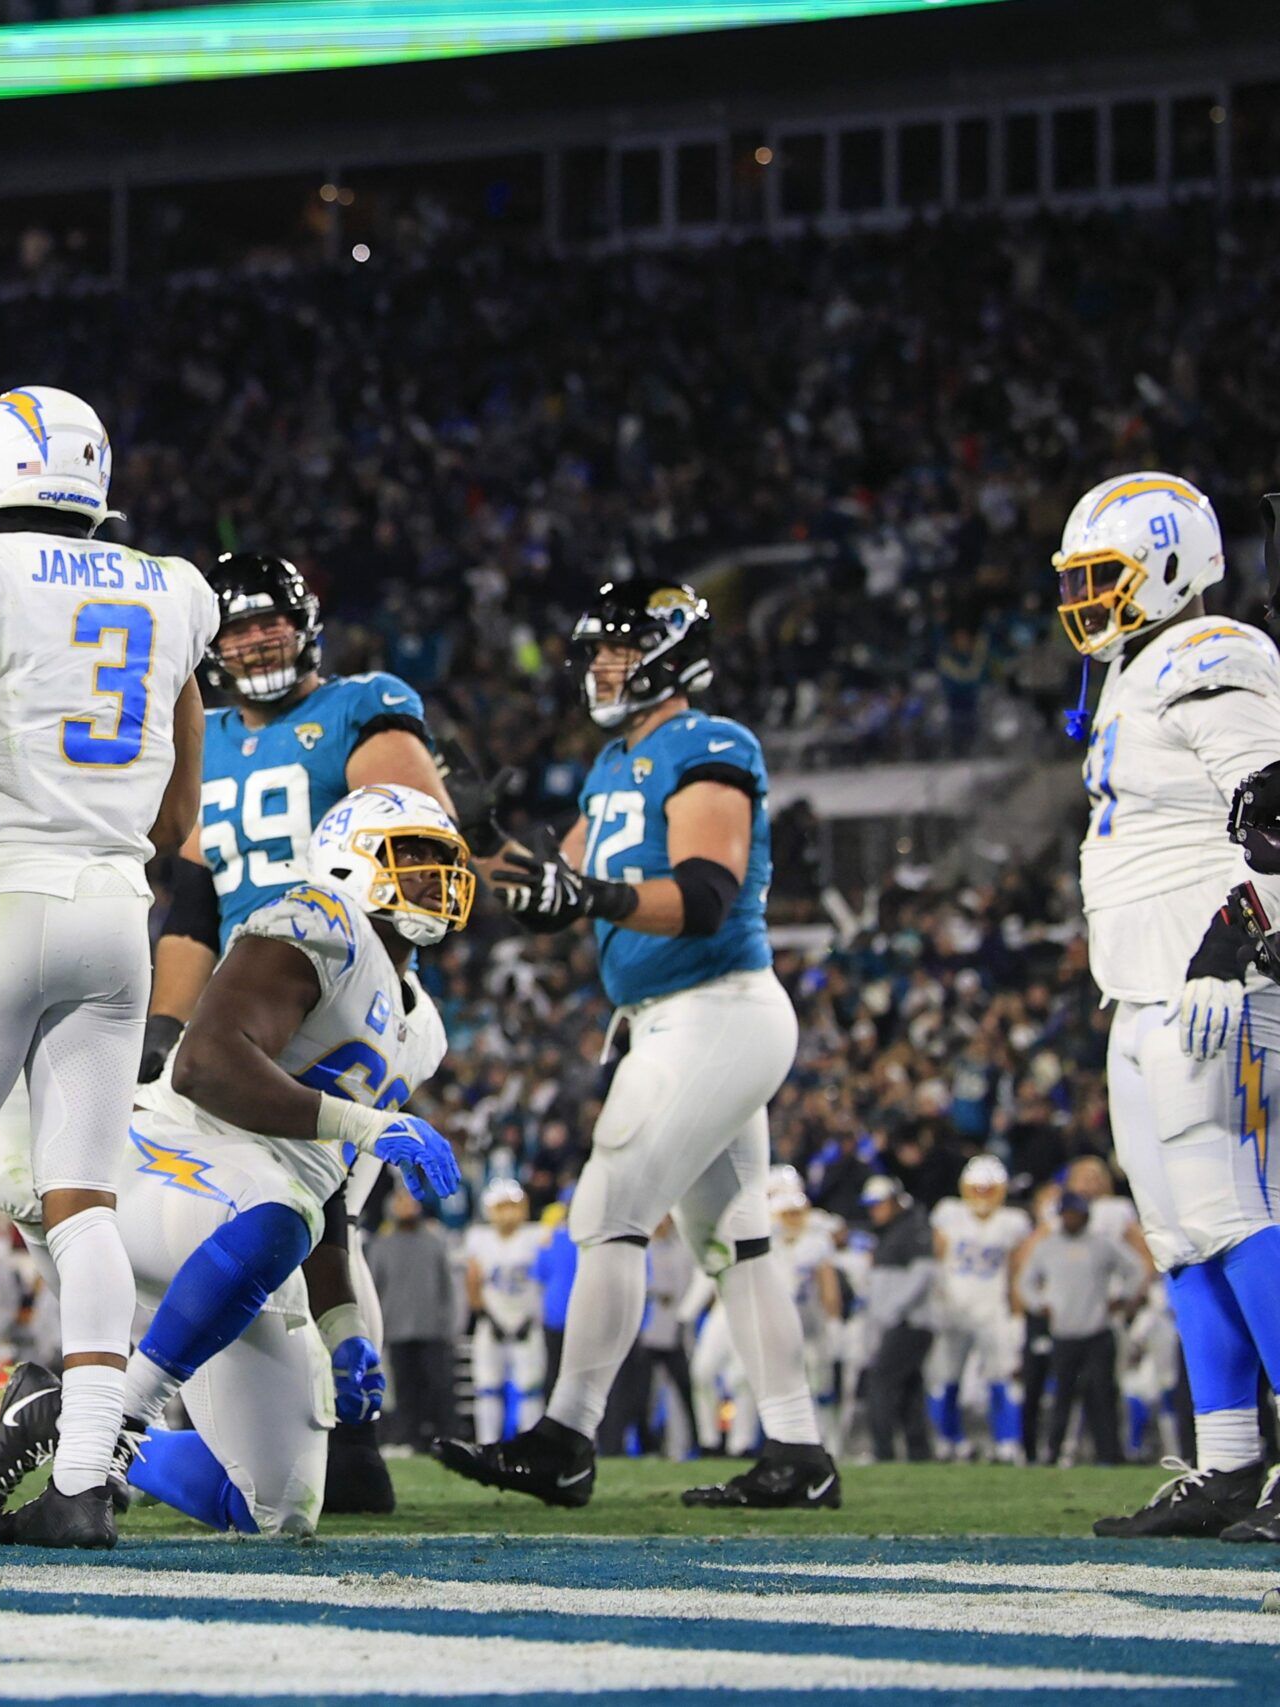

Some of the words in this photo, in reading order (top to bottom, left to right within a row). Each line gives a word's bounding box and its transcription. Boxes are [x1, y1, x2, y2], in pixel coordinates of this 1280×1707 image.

[38, 491, 101, 509] CHARGERS
[1149, 511, 1180, 550] 91
[31, 549, 125, 589] JAMES
[134, 558, 169, 592] JR
[58, 599, 158, 769] 3
[198, 762, 314, 897] 69
[581, 790, 646, 885] 72
